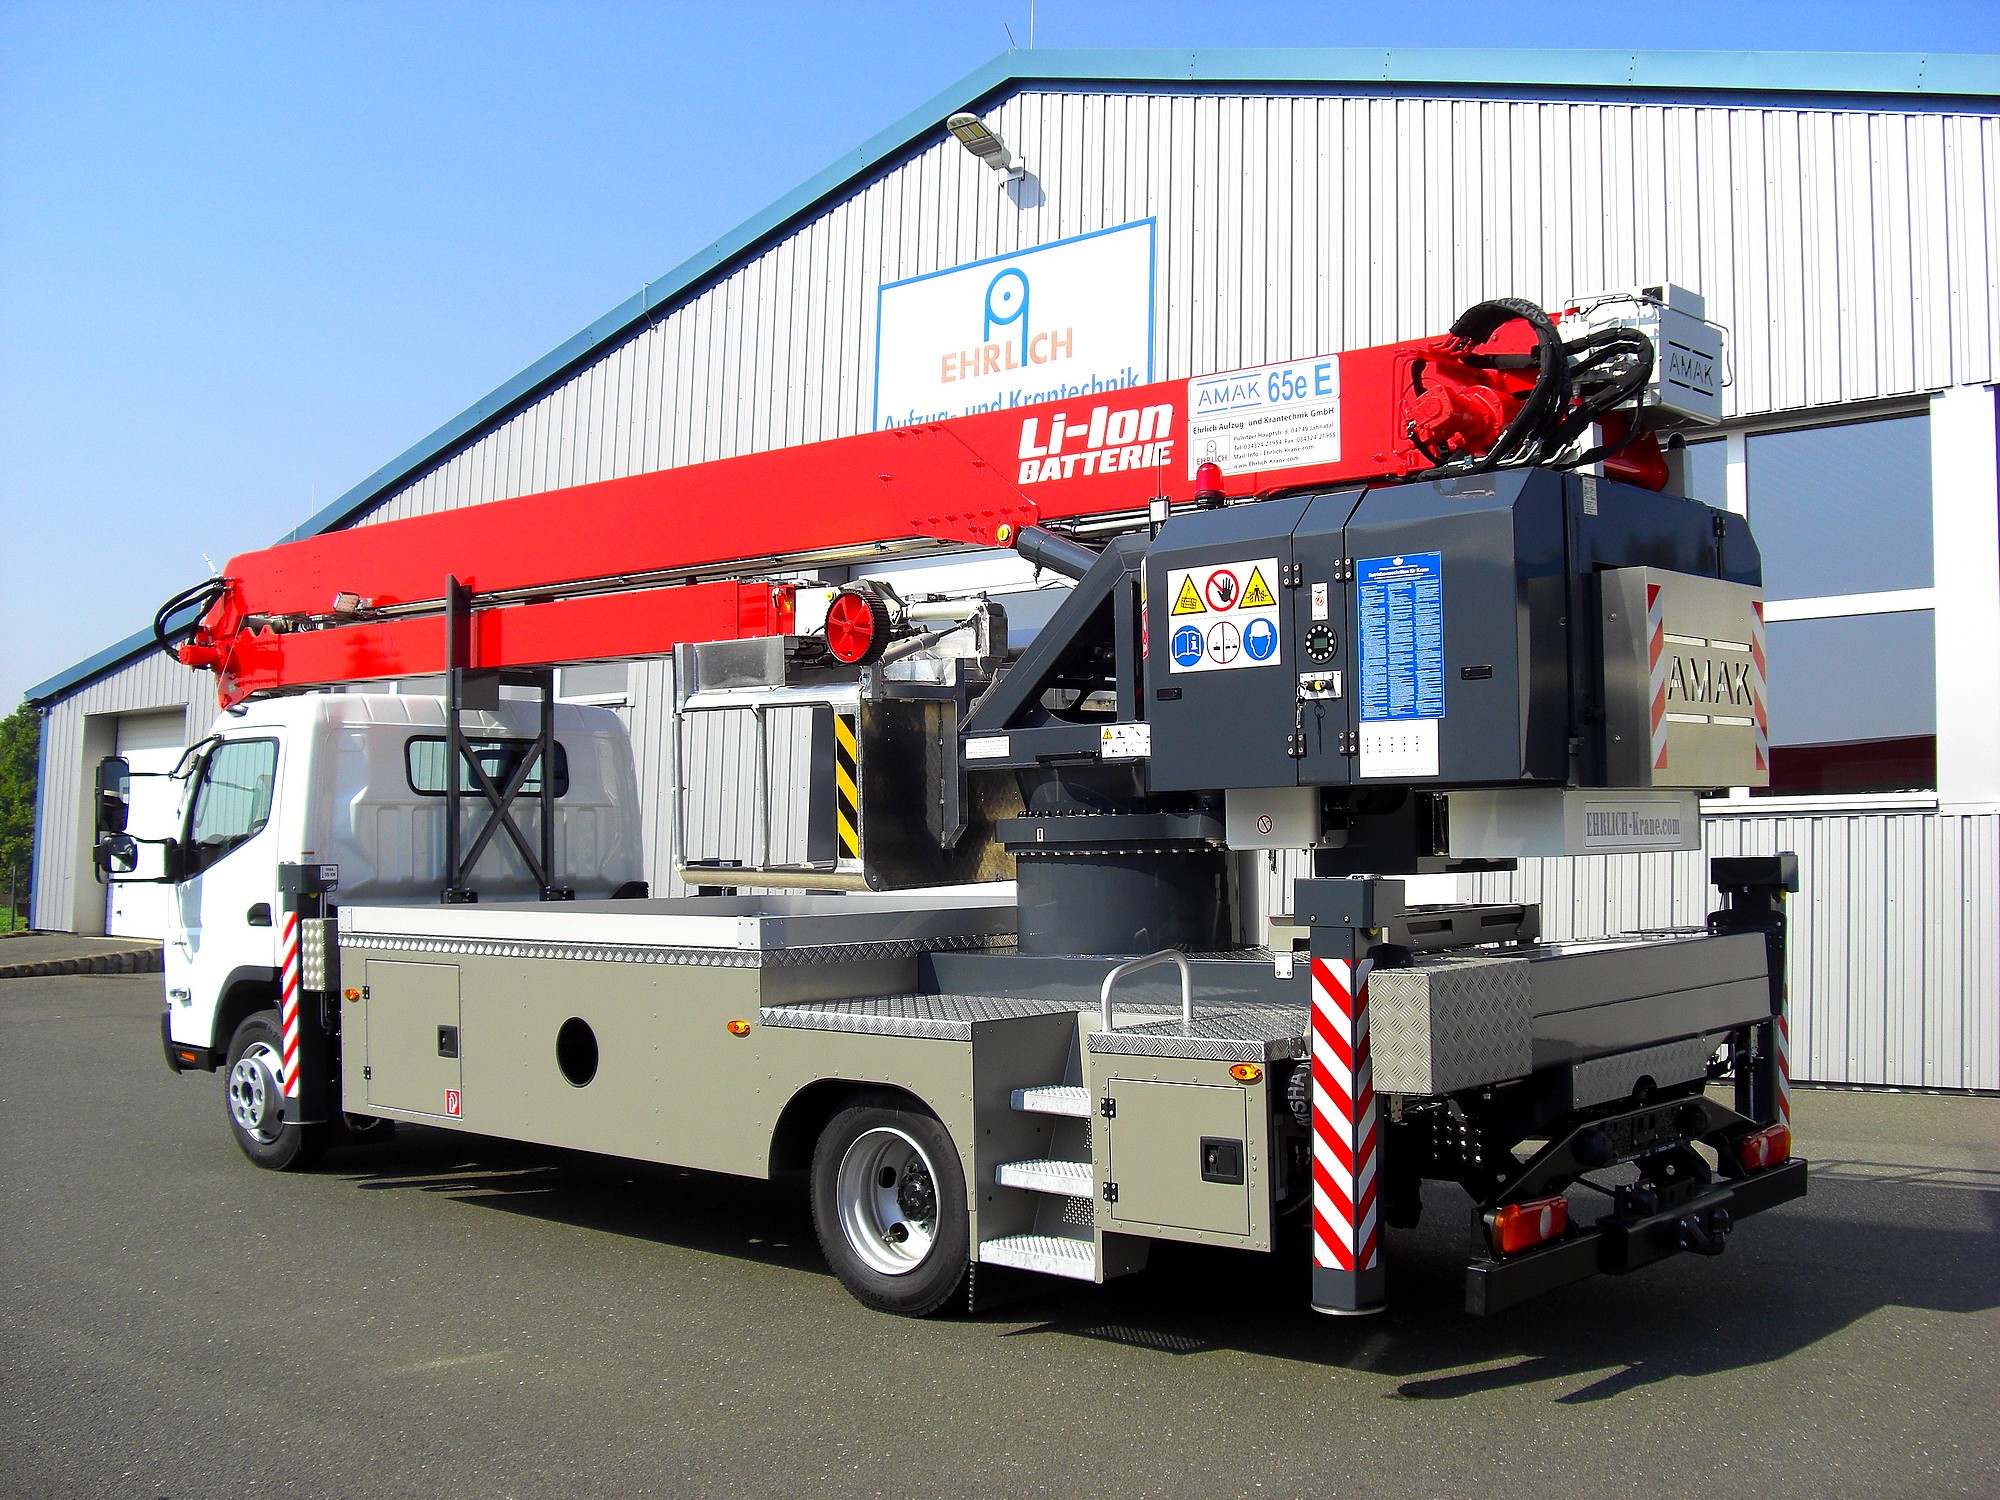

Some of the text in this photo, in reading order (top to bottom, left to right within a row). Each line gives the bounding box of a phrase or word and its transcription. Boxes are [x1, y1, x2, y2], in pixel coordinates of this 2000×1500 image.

[941, 328, 1072, 383] EHRLICH
[1670, 352, 1714, 387] AMAK
[1009, 367, 1139, 408] Krantechnik
[1199, 363, 1332, 407] AMAK 65e E
[1018, 404, 1173, 459] Li-Ion
[1193, 424, 1217, 434] Ehrlich
[1248, 417, 1263, 426] und
[1264, 410, 1309, 423] Krantechnik
[1311, 406, 1334, 417] GmbH
[1018, 440, 1174, 485] BATTERIE
[1667, 656, 1753, 706] AMAK
[1586, 812, 1680, 837] EHRLICH-Krane.com
